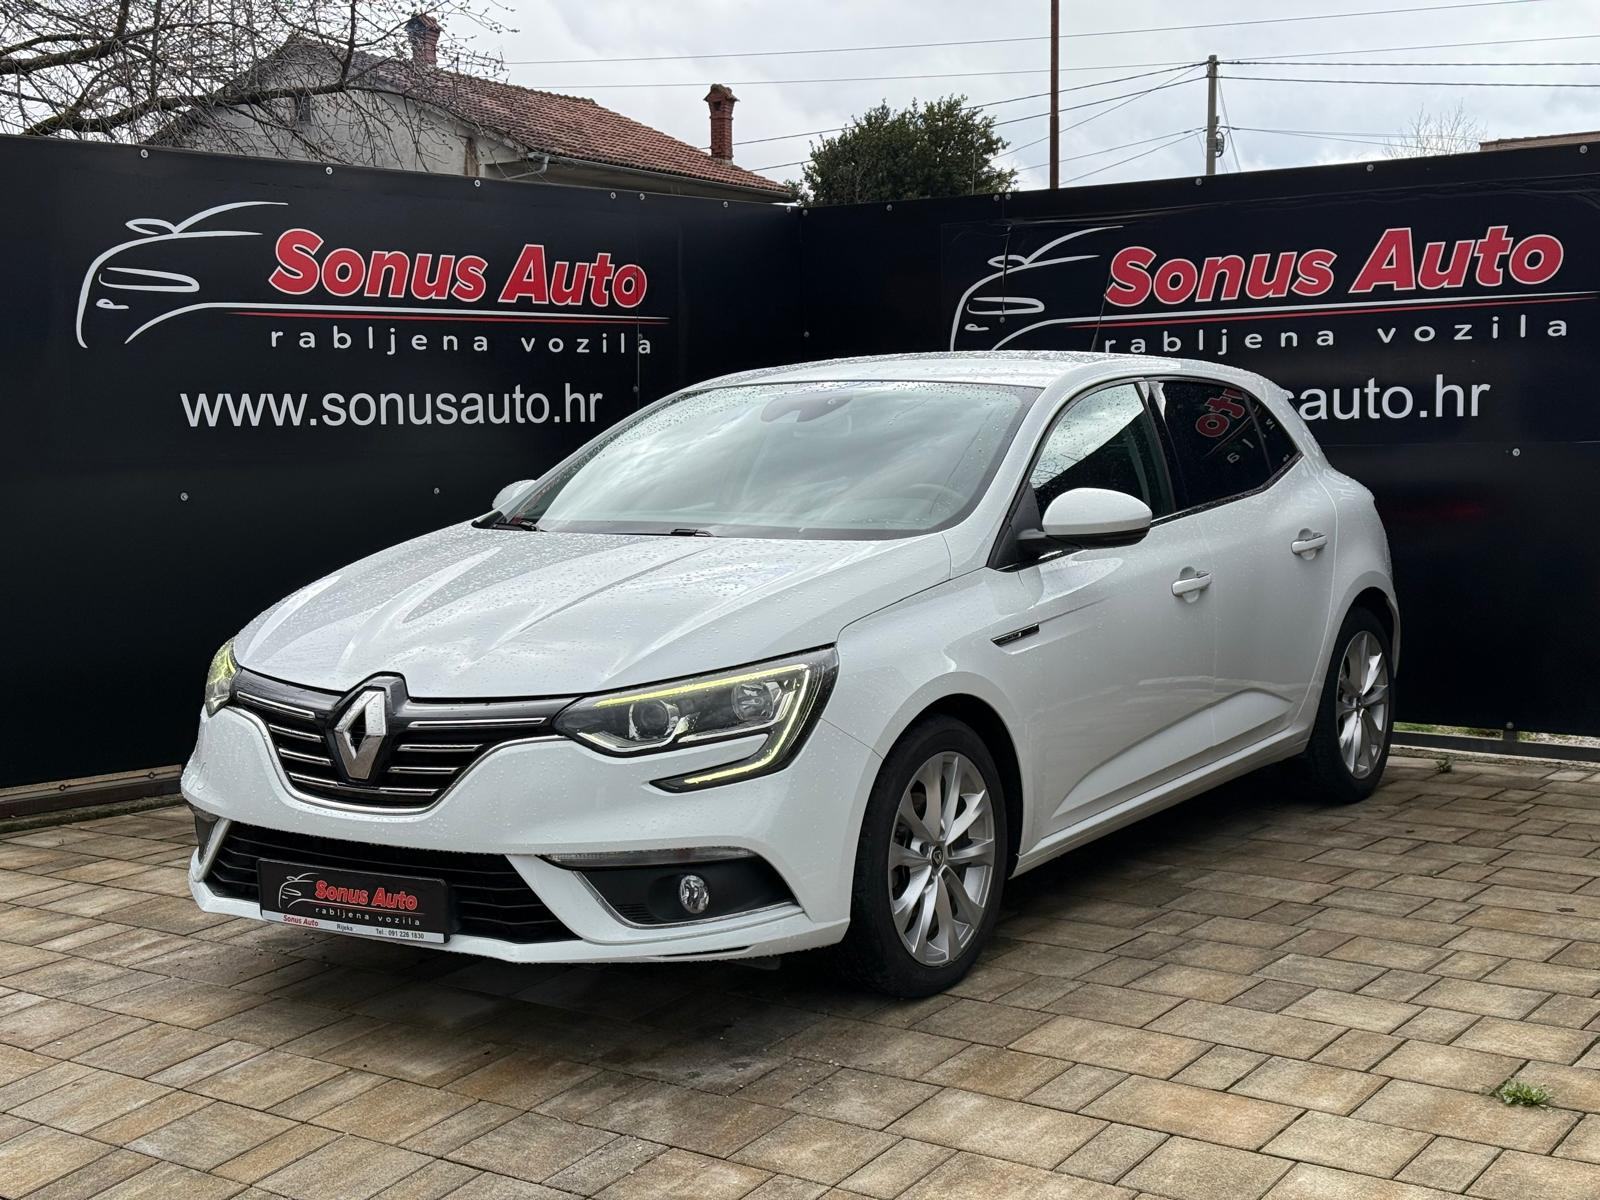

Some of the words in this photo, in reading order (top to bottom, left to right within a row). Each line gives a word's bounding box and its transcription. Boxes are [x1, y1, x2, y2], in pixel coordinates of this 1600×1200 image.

[268, 228, 486, 303] Sonus
[498, 243, 648, 309] Auto
[1104, 246, 1337, 307] Sonus
[1348, 224, 1565, 295] Auto
[271, 326, 488, 356] rabljena
[520, 332, 651, 355] vozila
[1104, 328, 1335, 355] rabljena
[1378, 314, 1567, 344] vozila
[180, 382, 604, 428] www.sonusauto.hr
[314, 879, 369, 905] Sonus
[371, 887, 418, 911] Auto
[283, 914, 301, 925] Sonus
[302, 918, 319, 928] Auto
[315, 907, 370, 921] rabljena
[377, 915, 421, 927] vozila
[336, 923, 354, 933] Rijeka
[388, 929, 398, 937] 091
